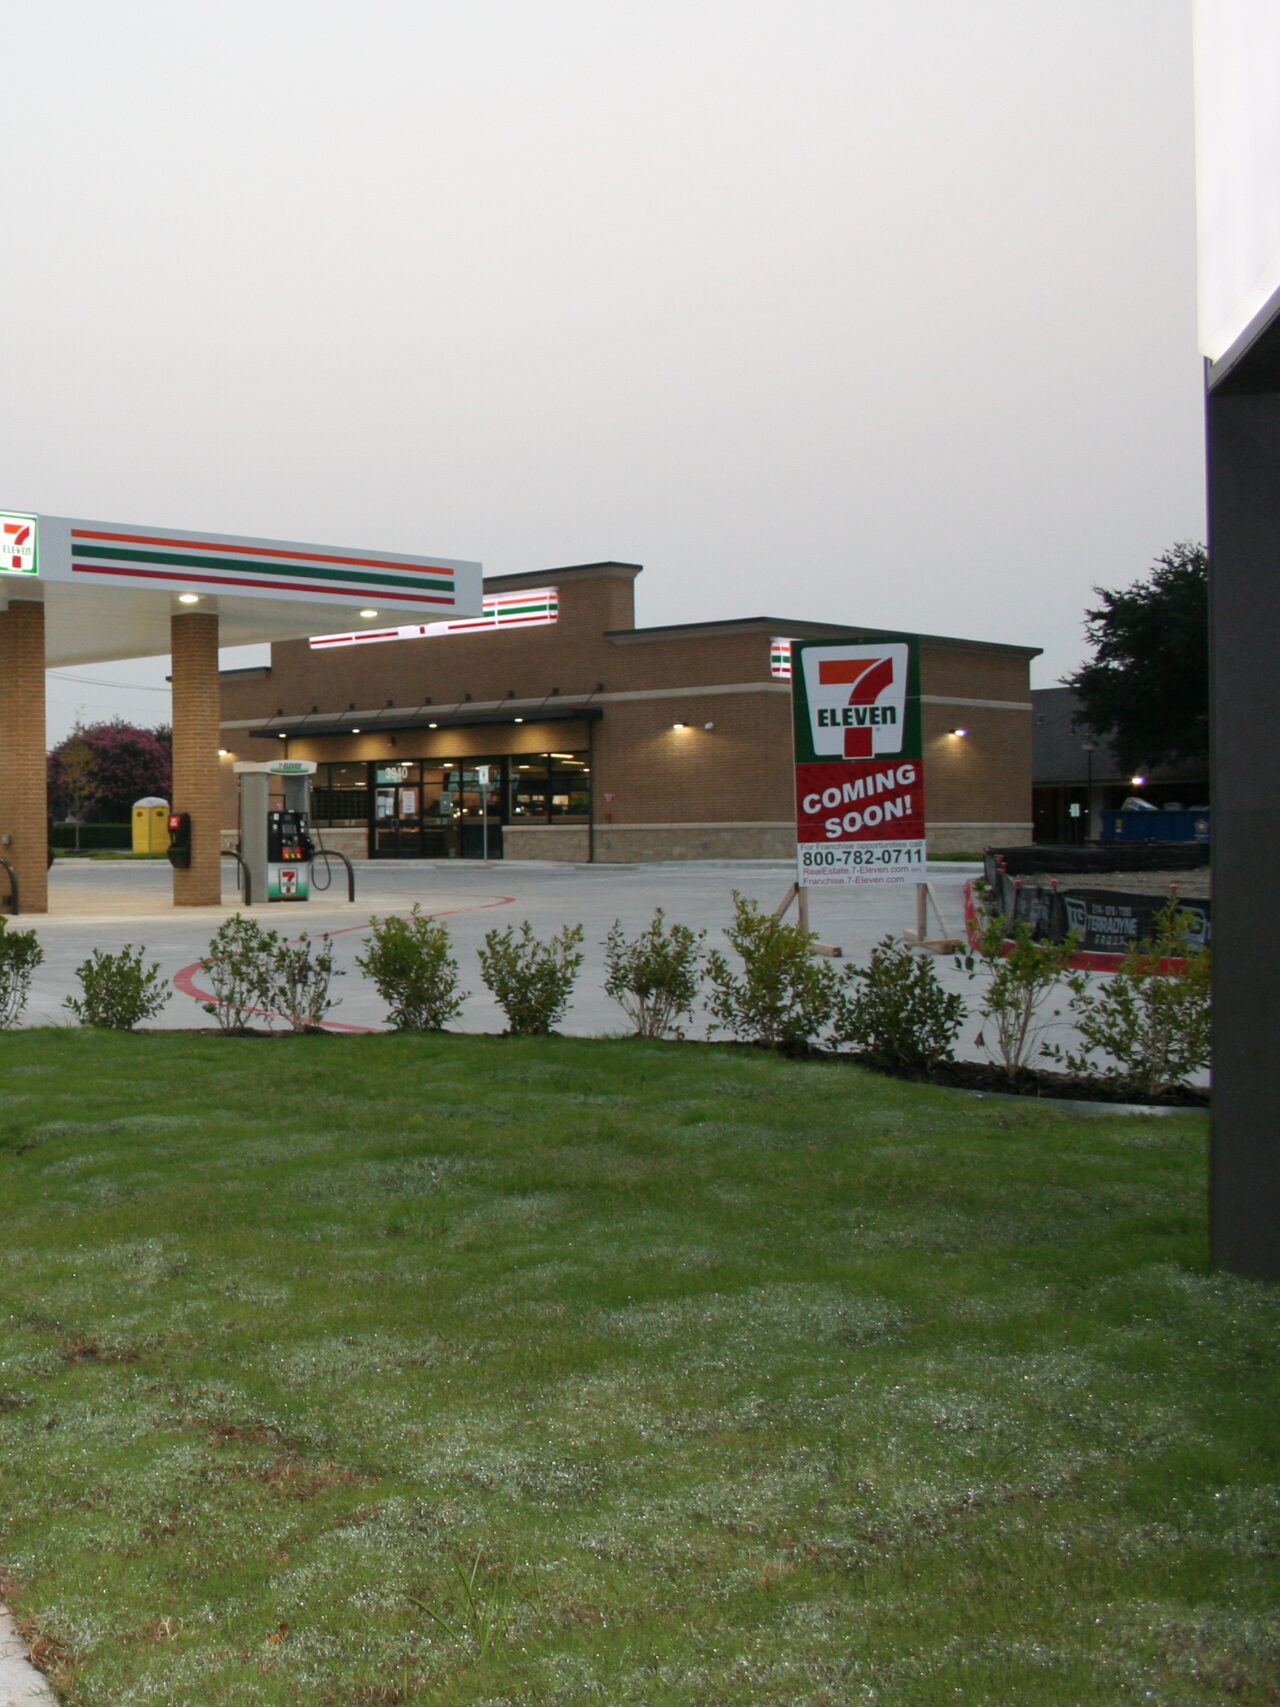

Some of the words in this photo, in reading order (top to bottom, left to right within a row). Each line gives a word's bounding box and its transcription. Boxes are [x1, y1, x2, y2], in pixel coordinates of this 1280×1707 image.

[3, 523, 30, 568] 7
[818, 657, 893, 758] 7
[802, 764, 916, 814] COMING
[825, 795, 913, 839] SOON!
[803, 848, 922, 867] 800-782-0711
[816, 842, 854, 850] Franchise
[856, 841, 907, 851] opportunities
